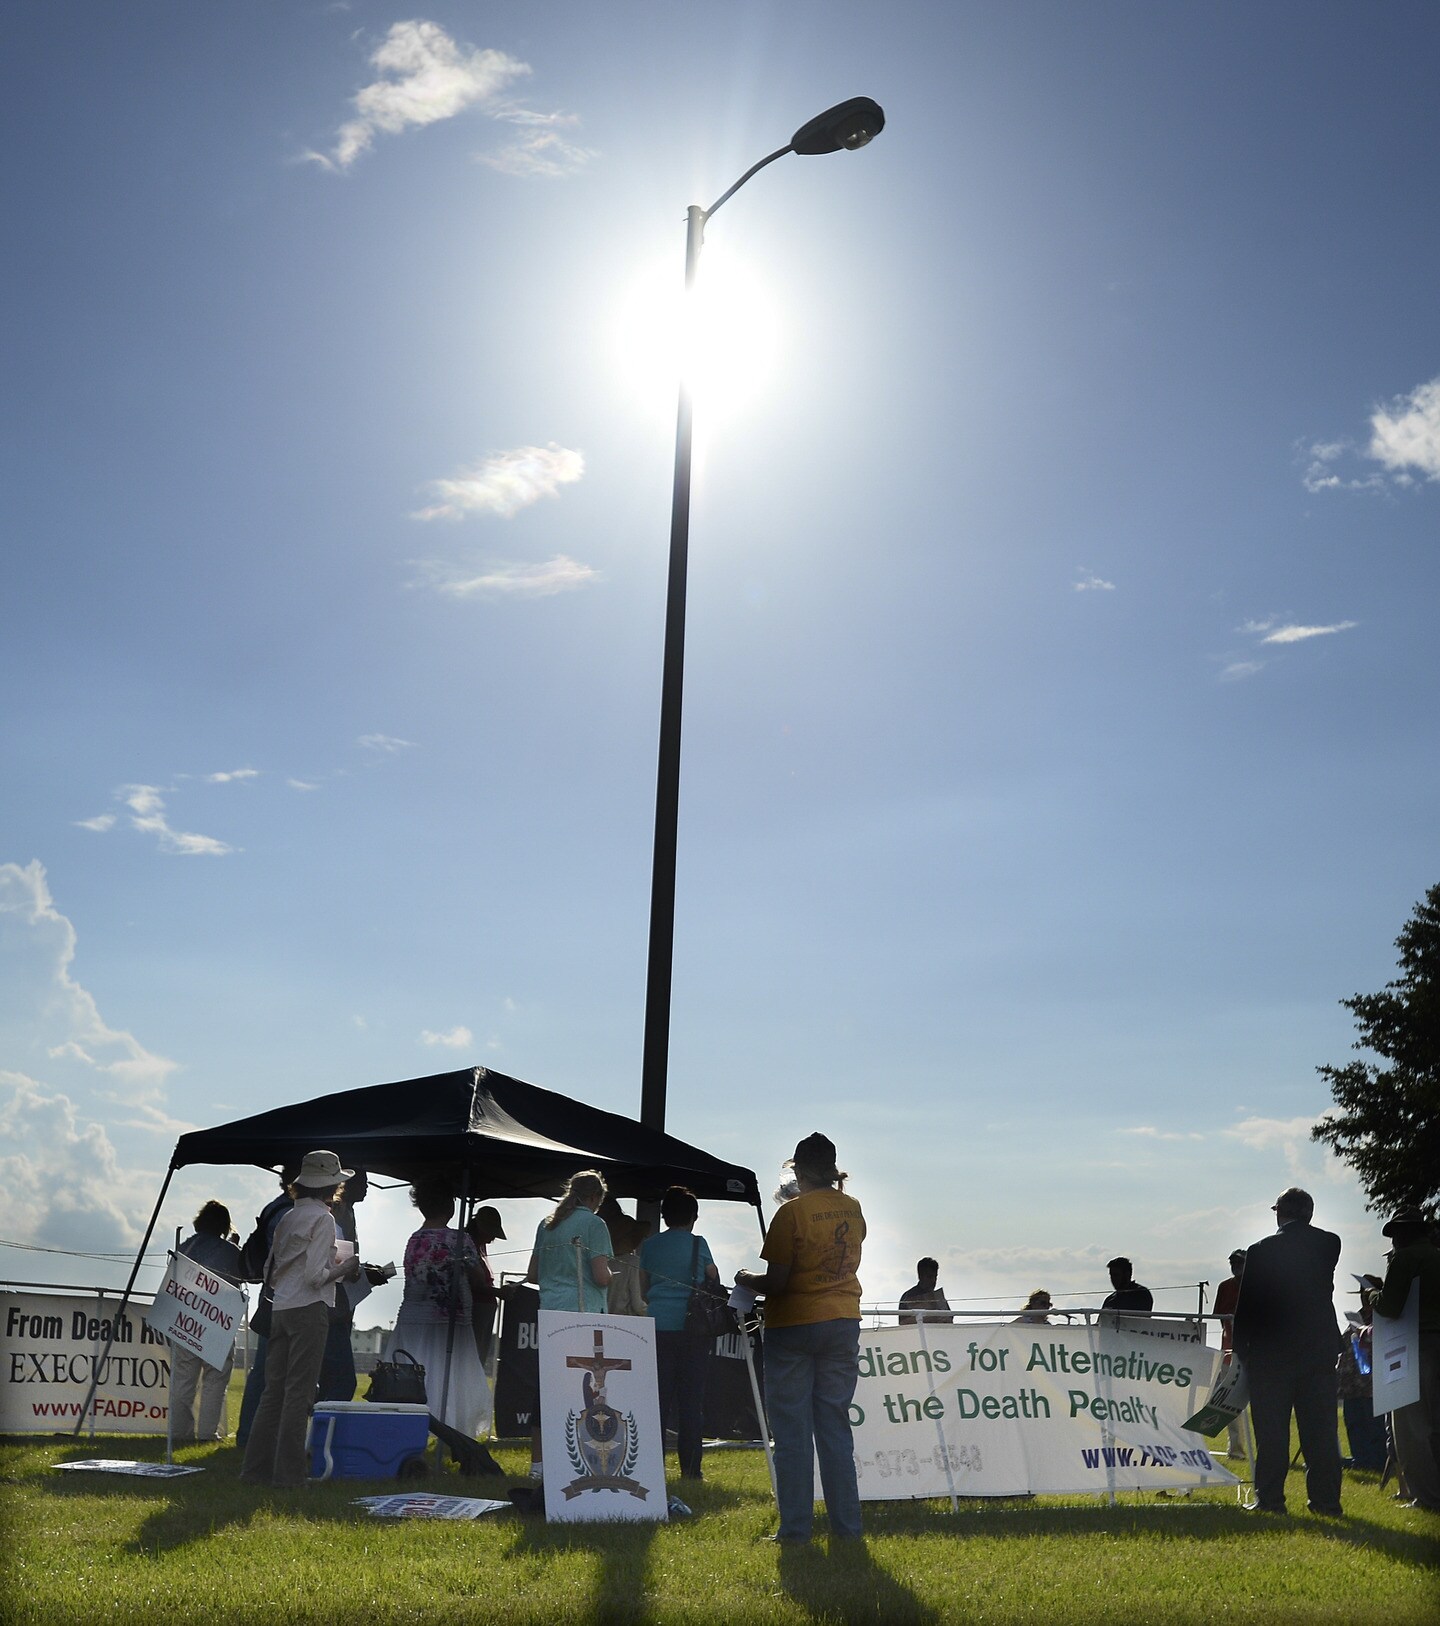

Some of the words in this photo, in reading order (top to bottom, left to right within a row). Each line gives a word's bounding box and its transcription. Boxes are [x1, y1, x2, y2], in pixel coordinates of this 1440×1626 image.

[195, 1272, 219, 1295] END
[165, 1279, 234, 1331] EXECUTIONS
[175, 1311, 207, 1339] NOW
[6, 1307, 63, 1340] From
[71, 1311, 133, 1344] Death
[141, 1317, 173, 1347] Ro
[168, 1326, 203, 1352] FADP.ORG
[858, 1346, 951, 1377] dians
[967, 1341, 1011, 1373] for
[1026, 1342, 1193, 1388] Alternatives
[883, 1393, 945, 1424] the
[957, 1388, 1051, 1420] Death
[1069, 1389, 1157, 1430] Penalty
